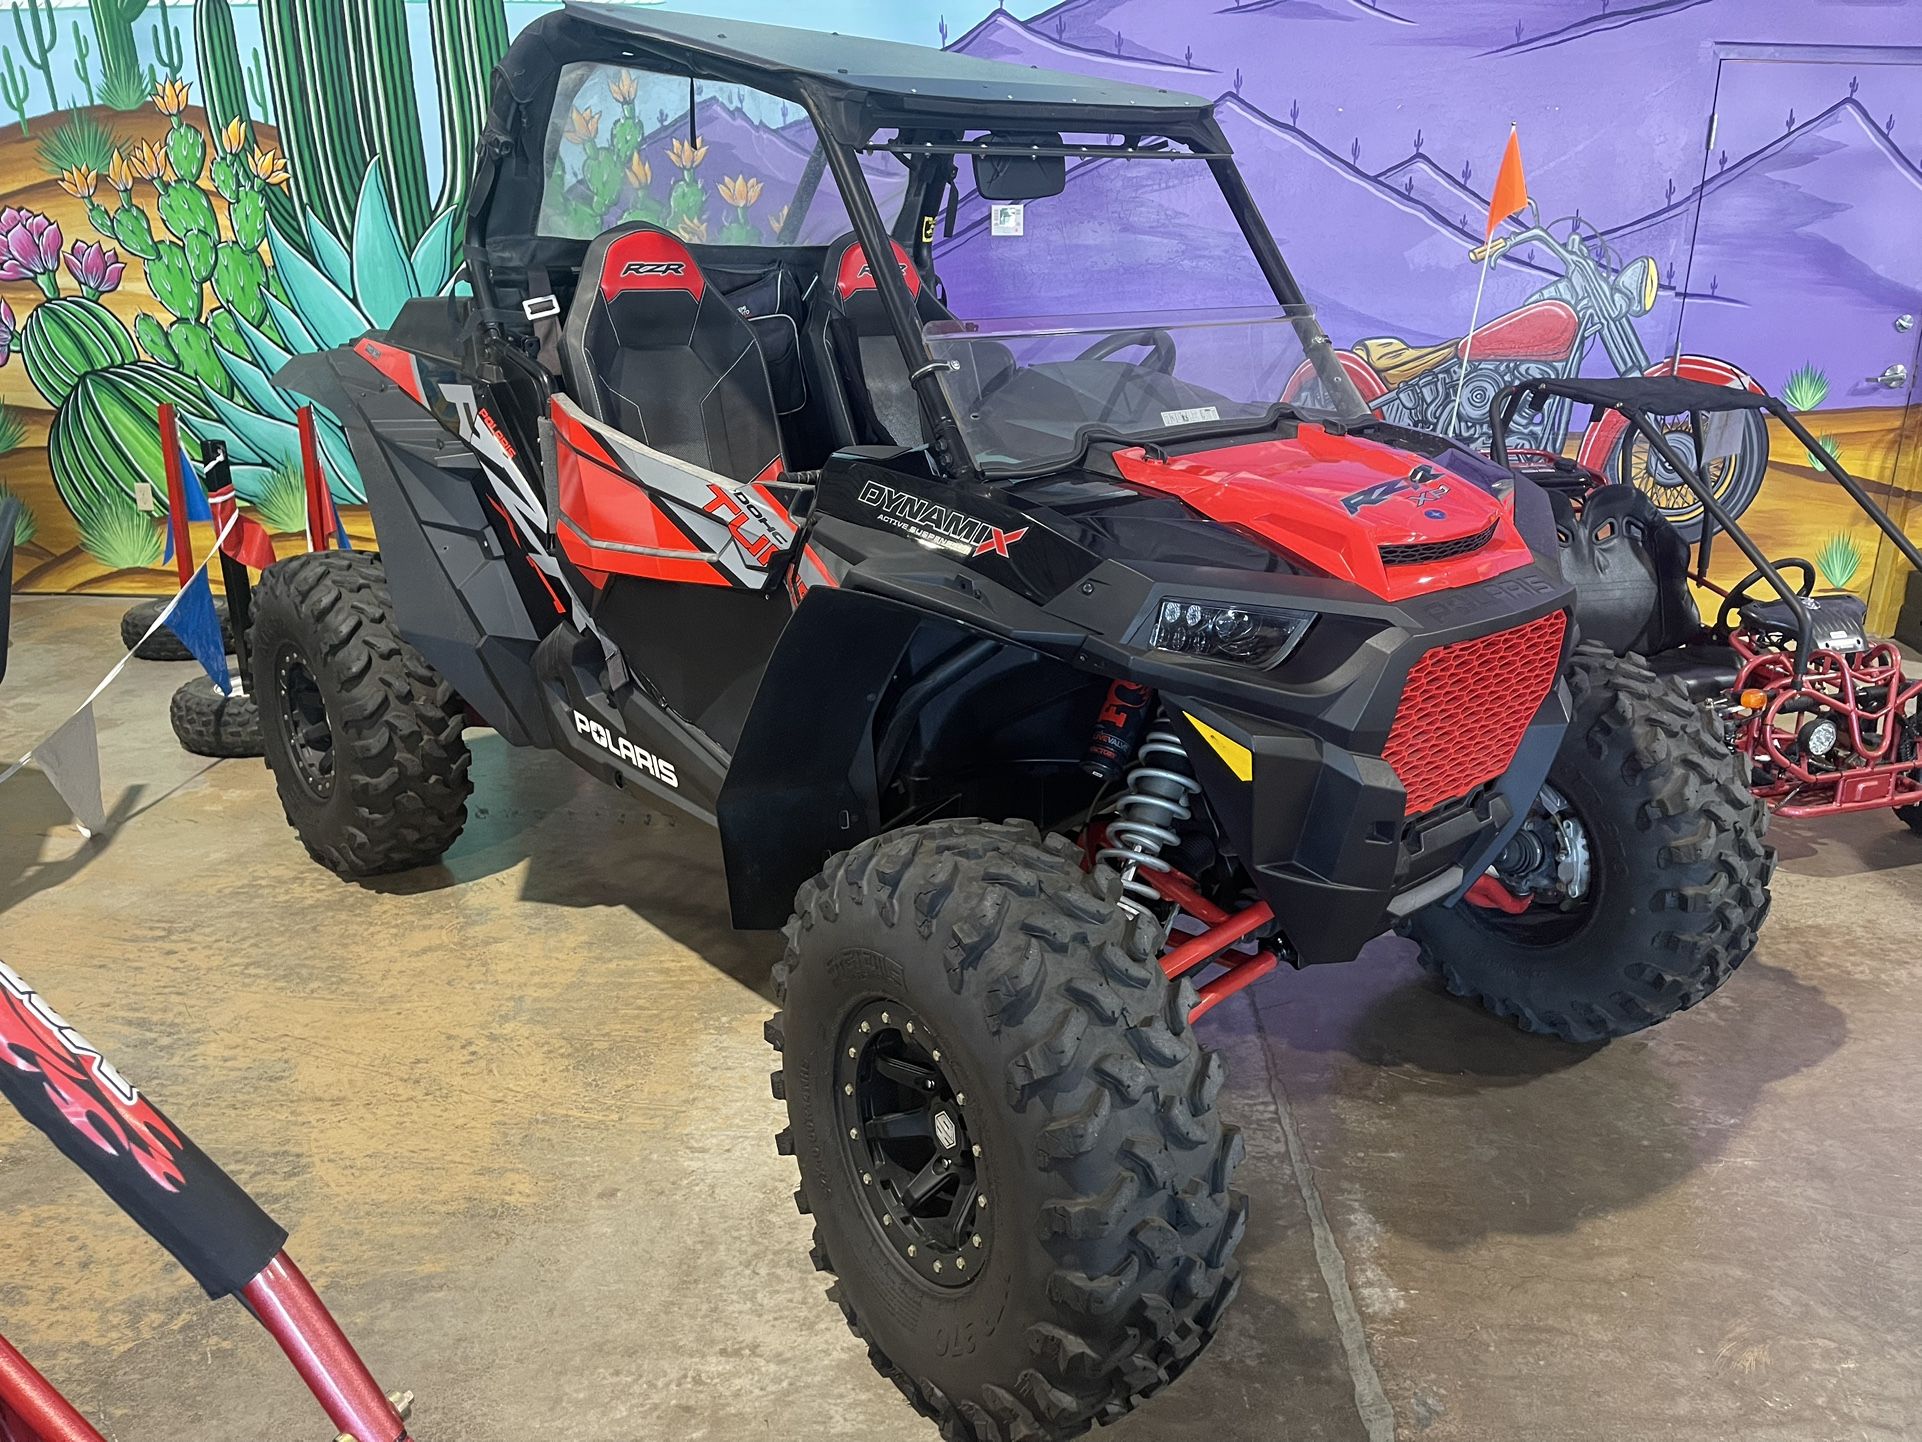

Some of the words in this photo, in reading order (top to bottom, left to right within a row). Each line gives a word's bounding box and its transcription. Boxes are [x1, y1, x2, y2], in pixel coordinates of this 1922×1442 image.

[620, 261, 686, 278] RZR
[478, 407, 517, 460] POLARIS
[1339, 464, 1446, 517] RZR
[1407, 484, 1450, 507] XP
[734, 491, 788, 545] DOHC
[858, 480, 1030, 558] DYNAMIX
[877, 513, 909, 532] ACTIVE
[573, 709, 679, 788] POLARIS
